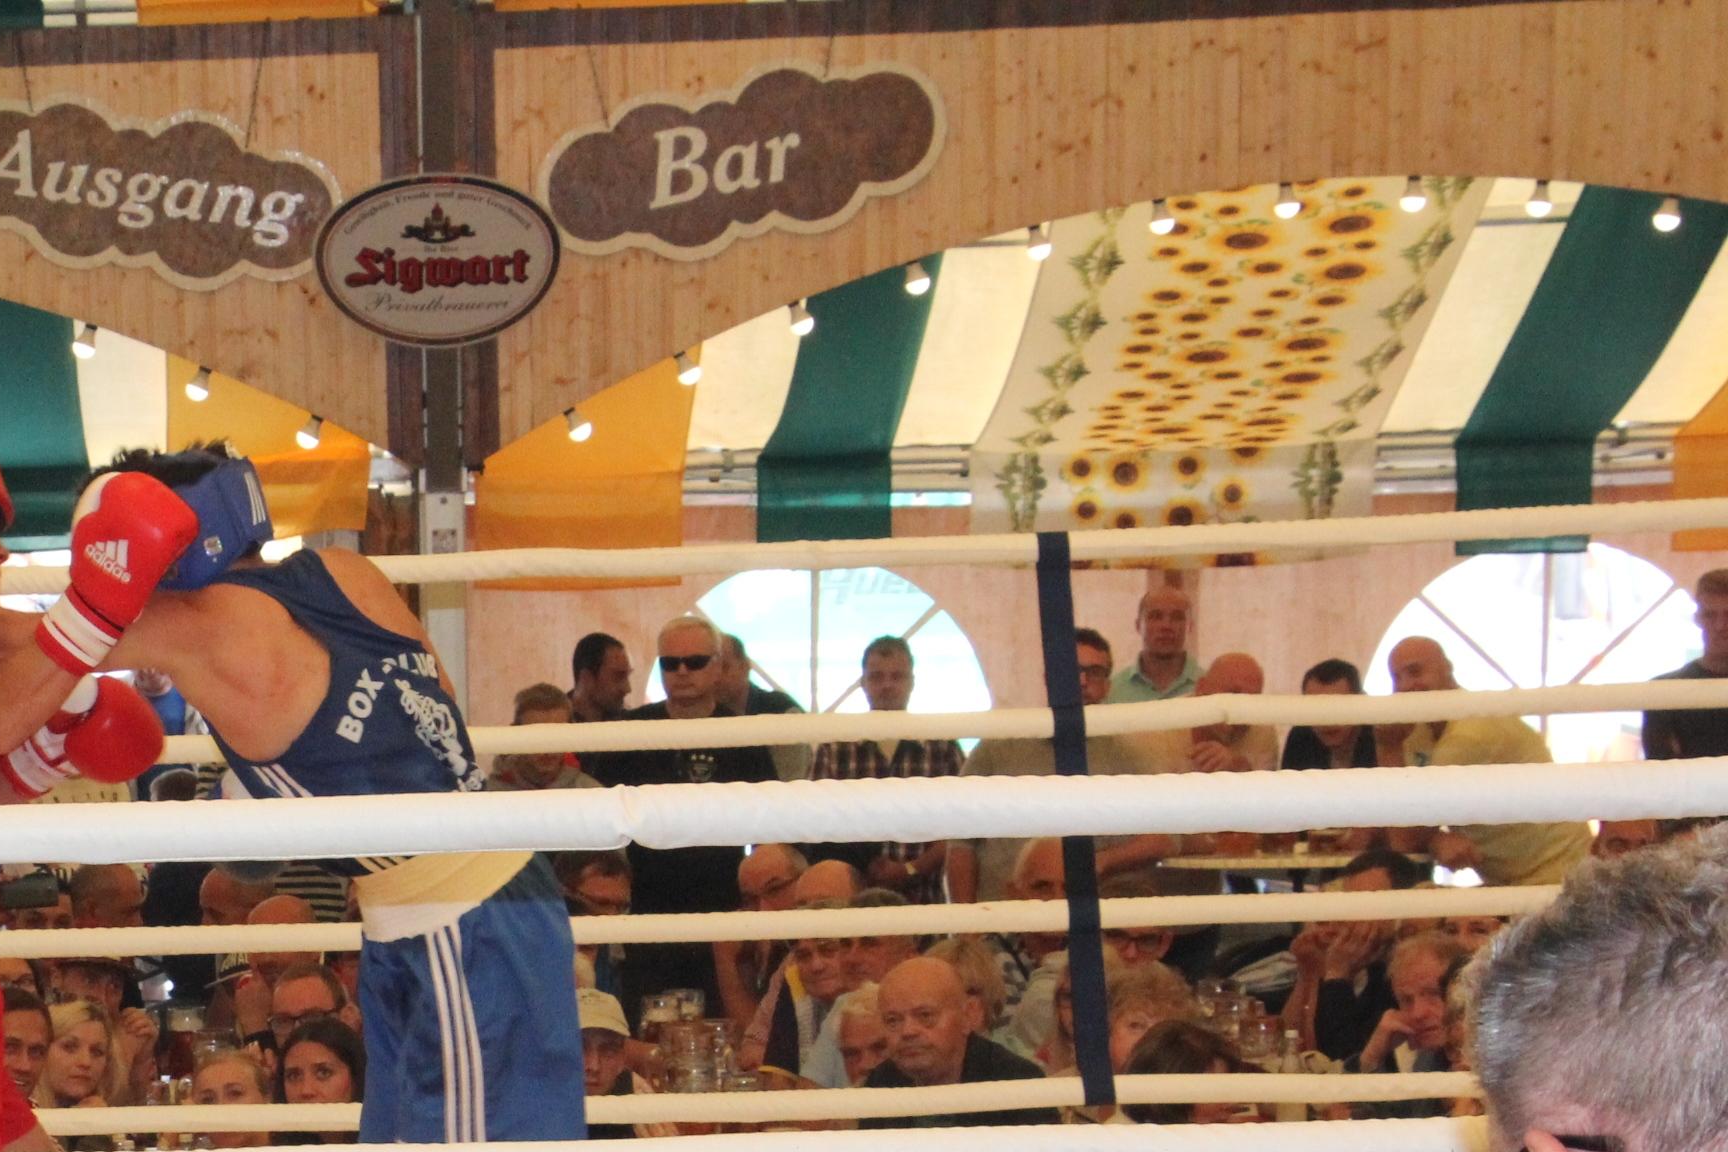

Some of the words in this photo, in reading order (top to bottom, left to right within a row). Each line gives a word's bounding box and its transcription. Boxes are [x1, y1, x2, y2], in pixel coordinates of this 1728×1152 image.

[649, 126, 801, 210] Bar
[345, 246, 531, 294] Sigwart
[85, 543, 131, 584] adidas
[336, 668, 384, 744] BOX
